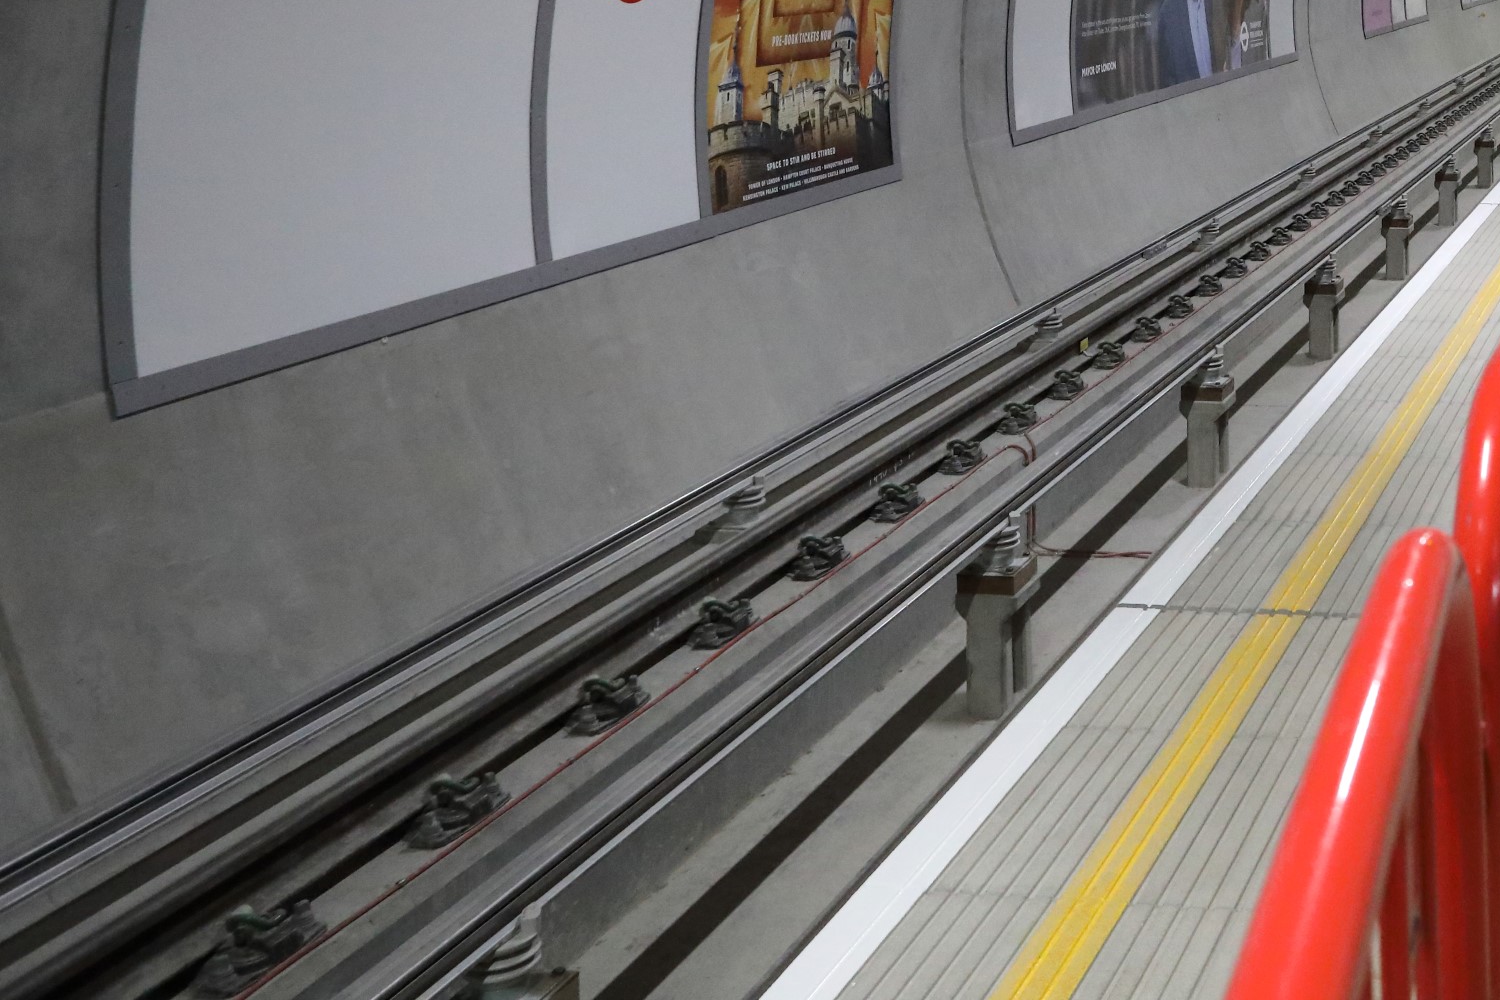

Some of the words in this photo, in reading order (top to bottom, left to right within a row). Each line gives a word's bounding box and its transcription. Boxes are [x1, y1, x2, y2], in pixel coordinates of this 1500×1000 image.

[772, 32, 798, 47] PRE-BOOK
[799, 30, 820, 44] TICKETS
[820, 29, 832, 41] NOW
[1082, 66, 1095, 77] MAYOR
[1101, 60, 1117, 73] LONDON
[766, 161, 782, 171] SPACE
[790, 156, 800, 165] STIR
[801, 153, 811, 162] AND
